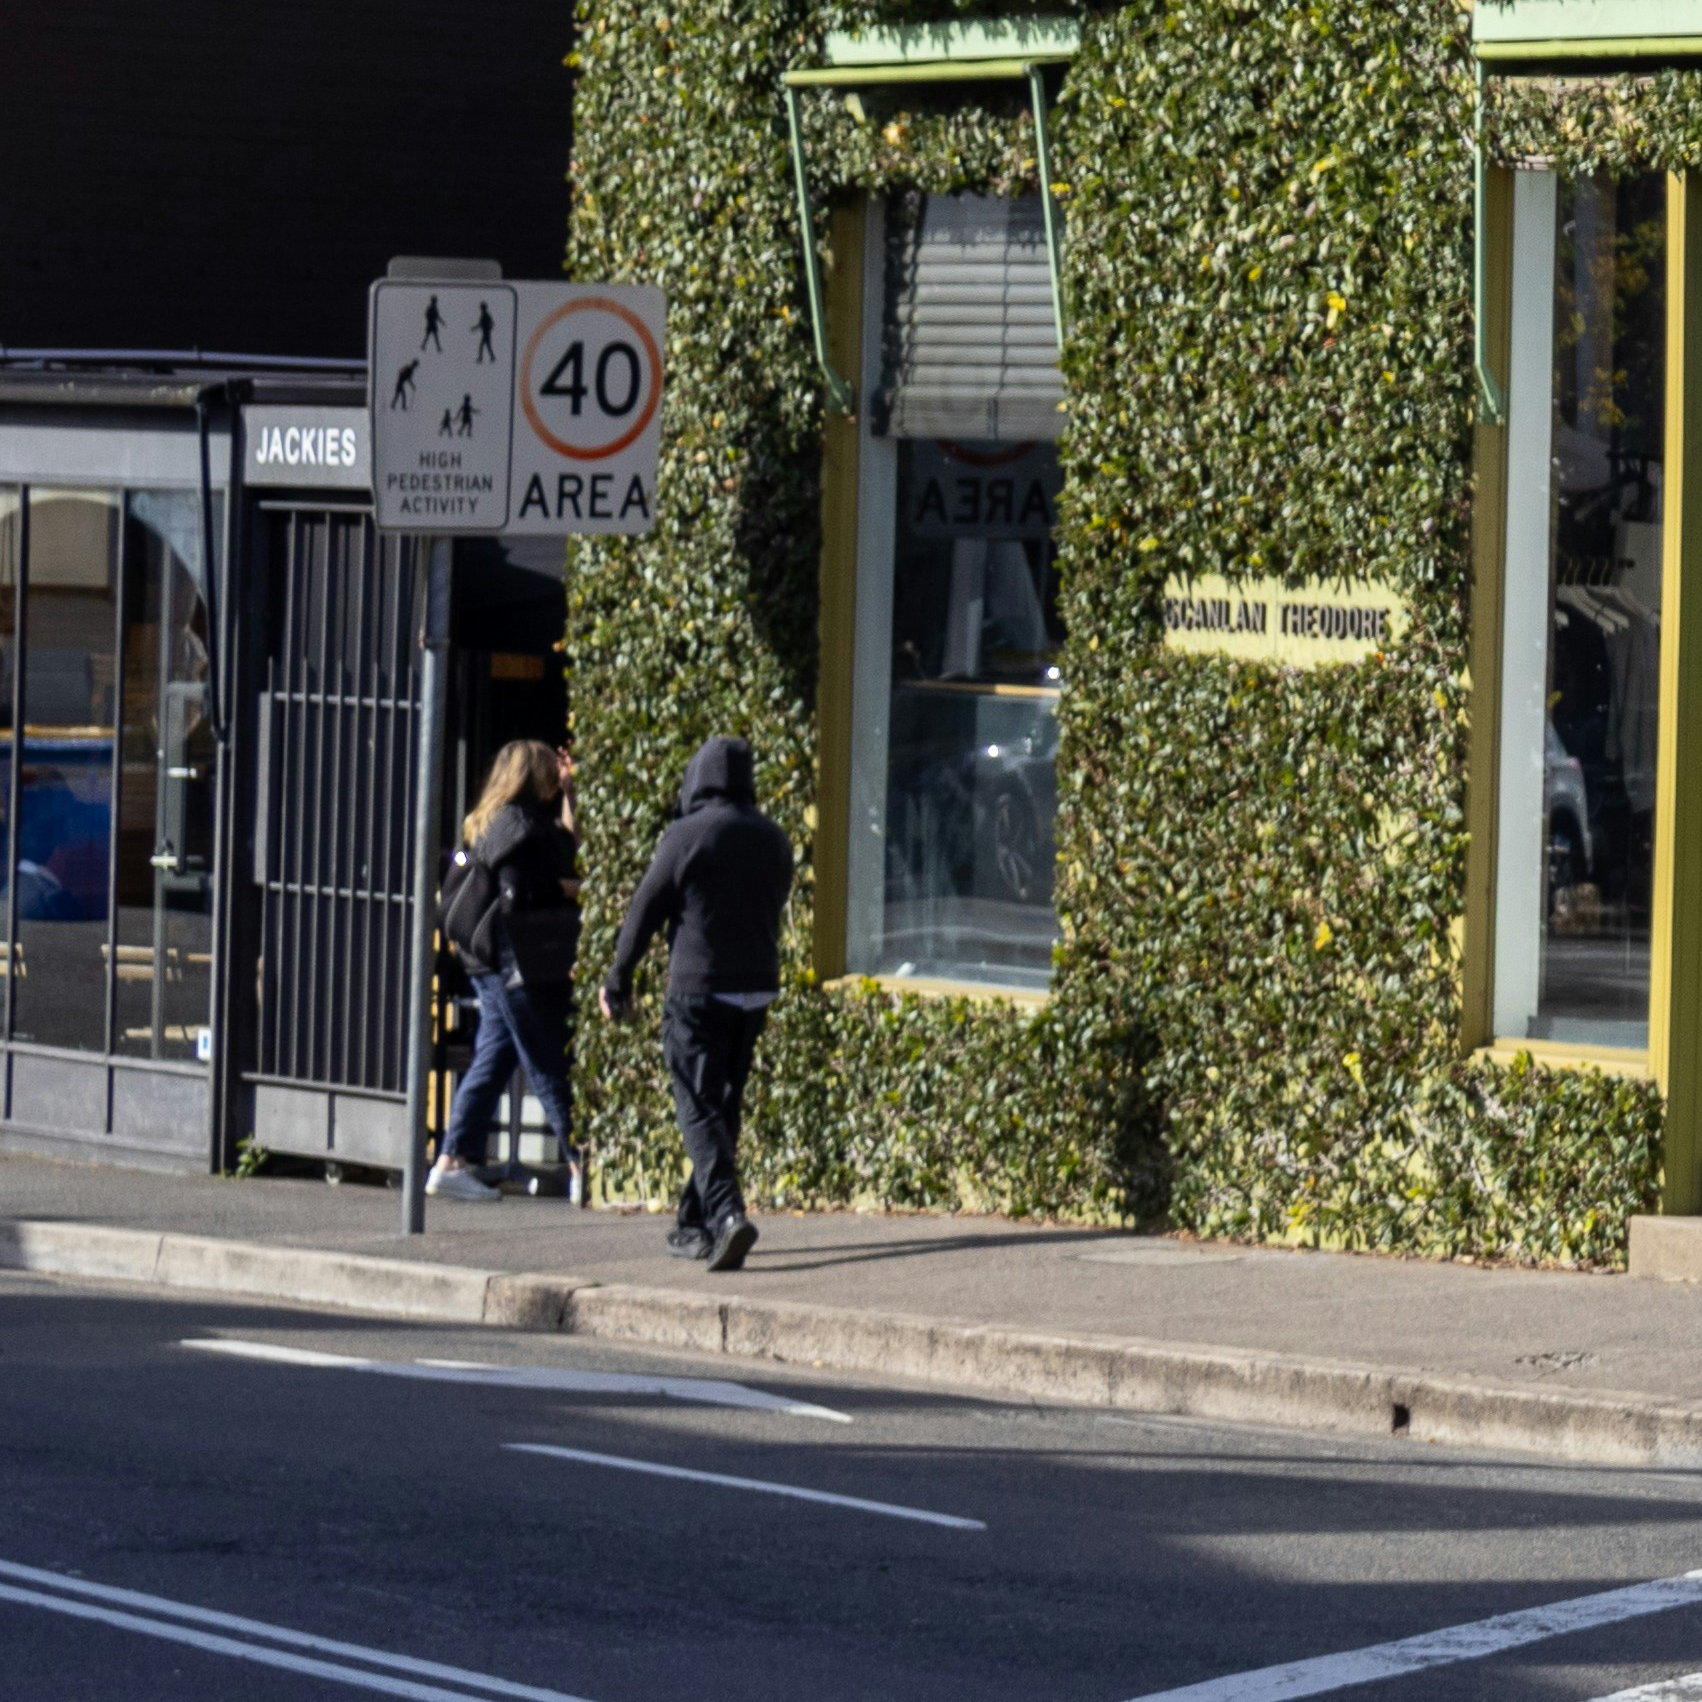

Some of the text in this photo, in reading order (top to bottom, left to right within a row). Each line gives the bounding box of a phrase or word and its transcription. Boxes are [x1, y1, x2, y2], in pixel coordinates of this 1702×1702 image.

[540, 340, 641, 417] 40
[256, 426, 356, 467] JACKIES
[419, 451, 462, 468] HIGH
[387, 473, 494, 493] PEDESTRIAN
[519, 472, 650, 520] AREA
[400, 496, 479, 515] ACTIVITY
[1165, 597, 1390, 641] SCANLAN THEODORE
